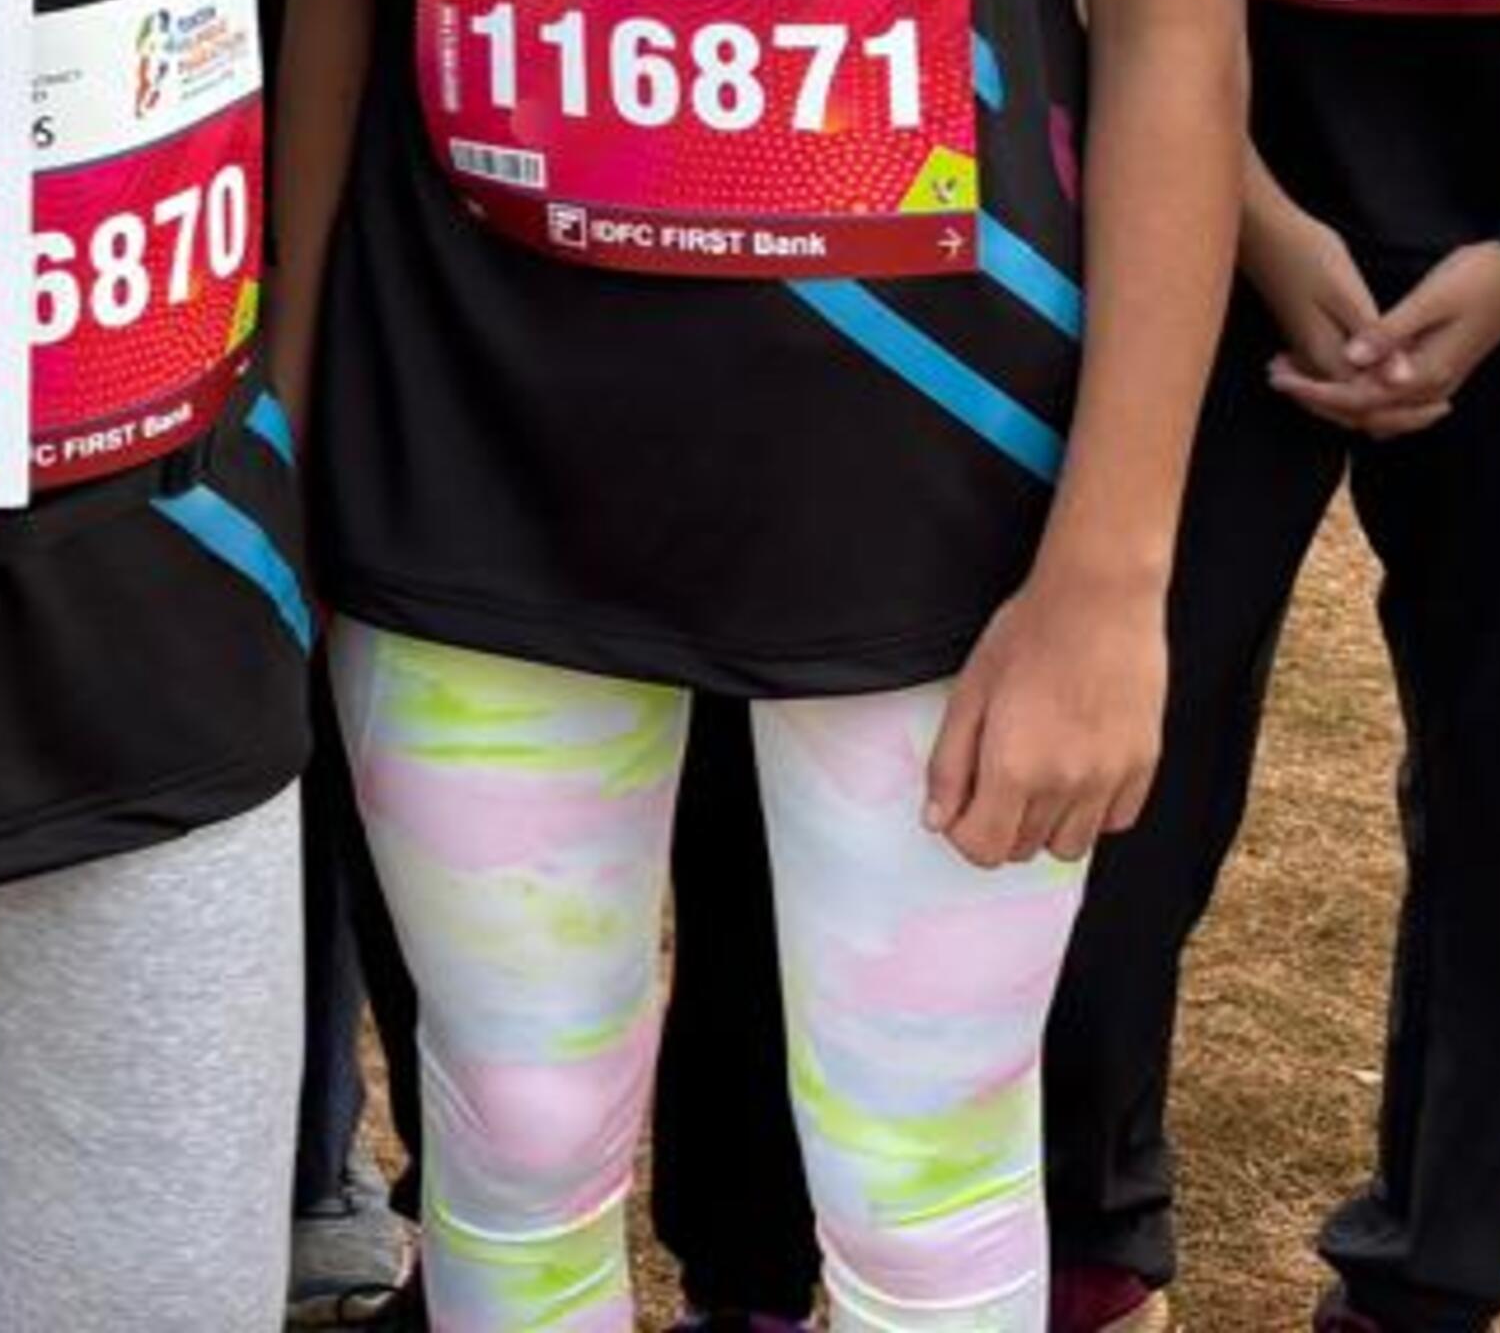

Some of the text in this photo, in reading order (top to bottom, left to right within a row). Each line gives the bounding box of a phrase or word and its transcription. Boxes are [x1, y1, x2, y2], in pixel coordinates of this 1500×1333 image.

[469, 1, 923, 133] 116871
[591, 216, 827, 258] IDFC FIRST Bank
[63, 423, 138, 462] FIRST
